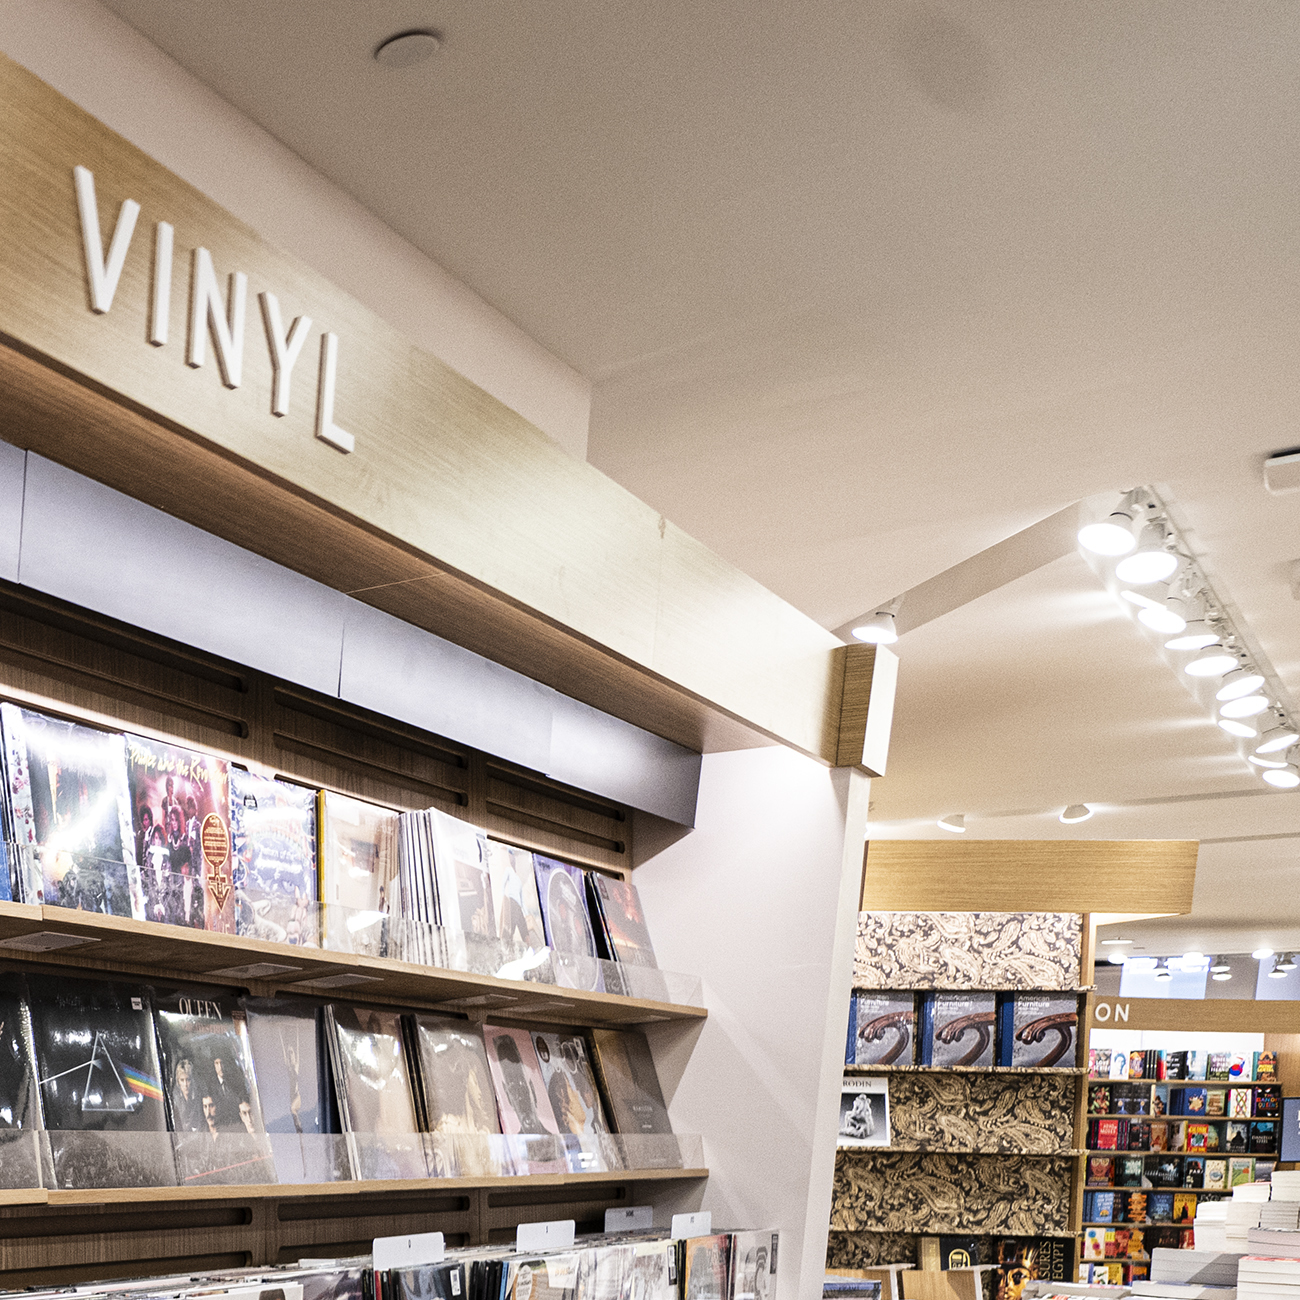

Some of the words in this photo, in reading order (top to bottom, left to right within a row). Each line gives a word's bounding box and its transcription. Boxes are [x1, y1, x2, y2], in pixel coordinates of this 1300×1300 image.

[74, 165, 355, 455] VINYL
[178, 997, 223, 1021] QUEEN
[842, 1080, 872, 1088] RODIN
[1040, 1241, 1051, 1281] SURES
[1052, 1241, 1064, 1280] EGYPT
